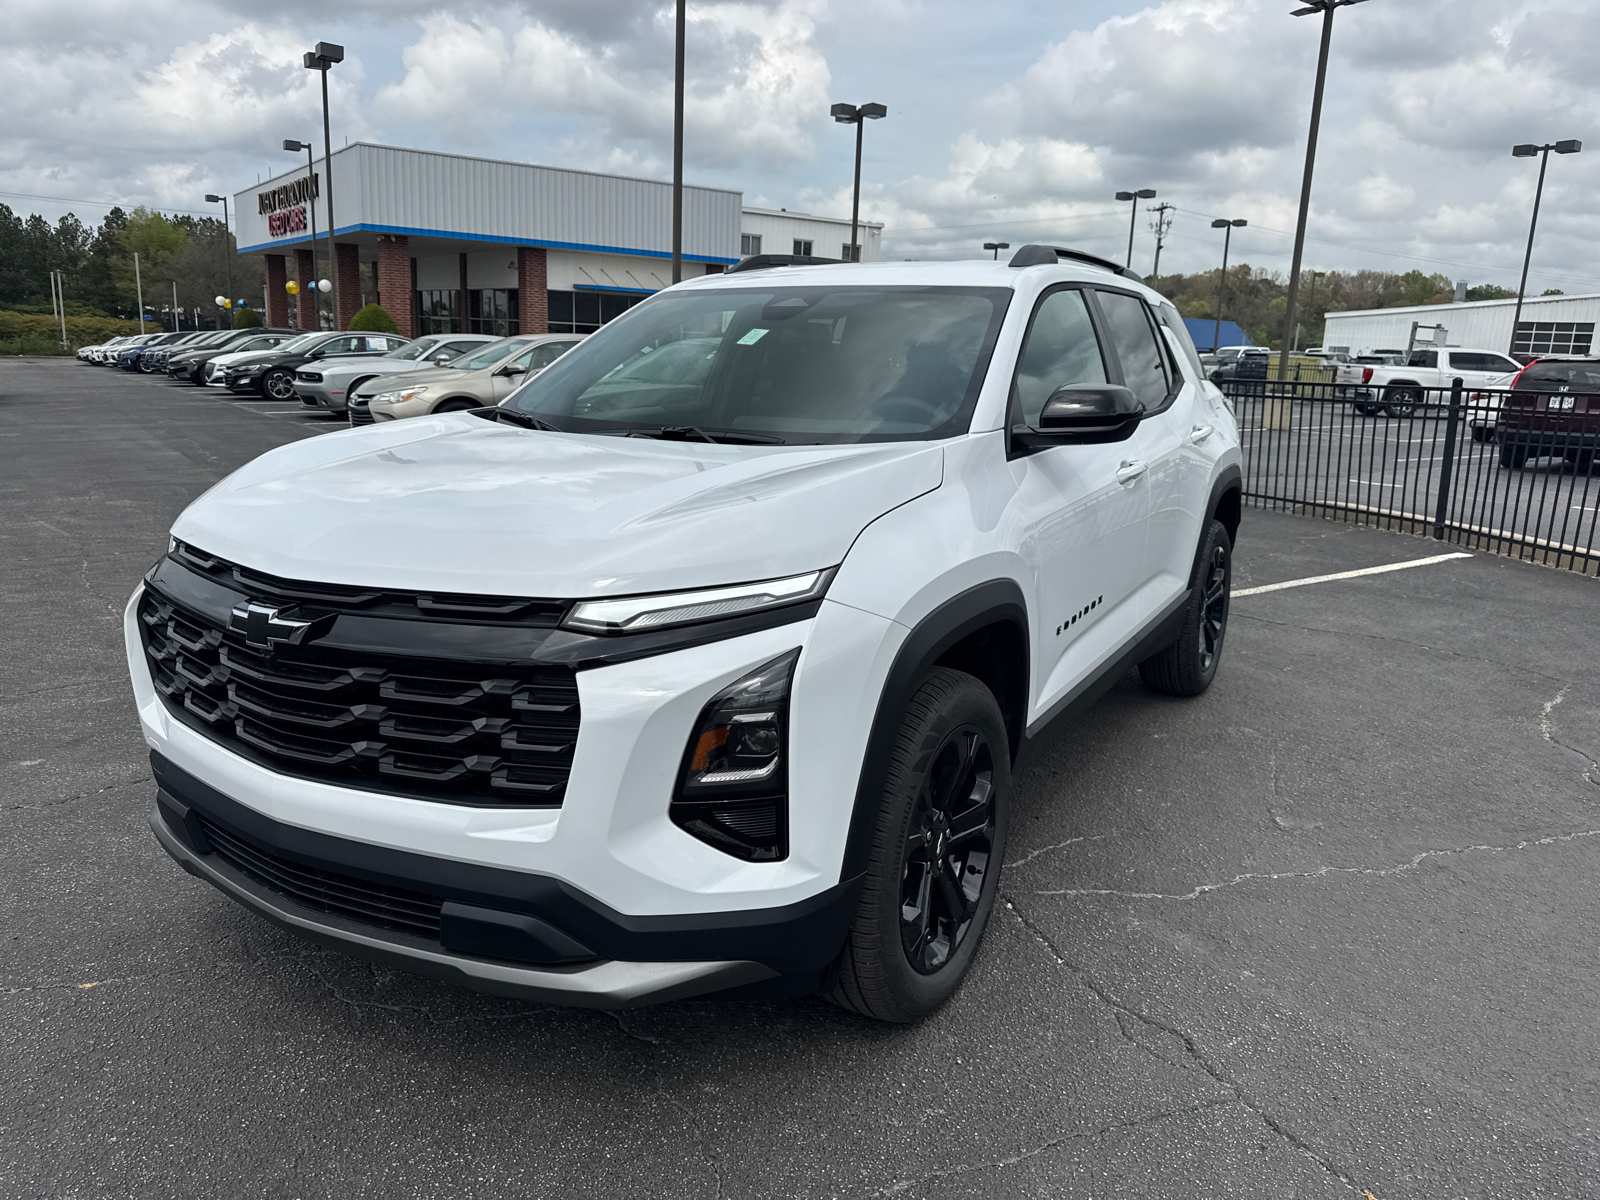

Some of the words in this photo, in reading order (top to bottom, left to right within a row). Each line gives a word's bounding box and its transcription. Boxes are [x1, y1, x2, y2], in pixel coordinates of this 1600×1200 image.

[274, 173, 319, 209] THORNTON
[268, 212, 286, 236] USED
[285, 206, 307, 232] CARS
[1056, 595, 1103, 636] EQUINOX
